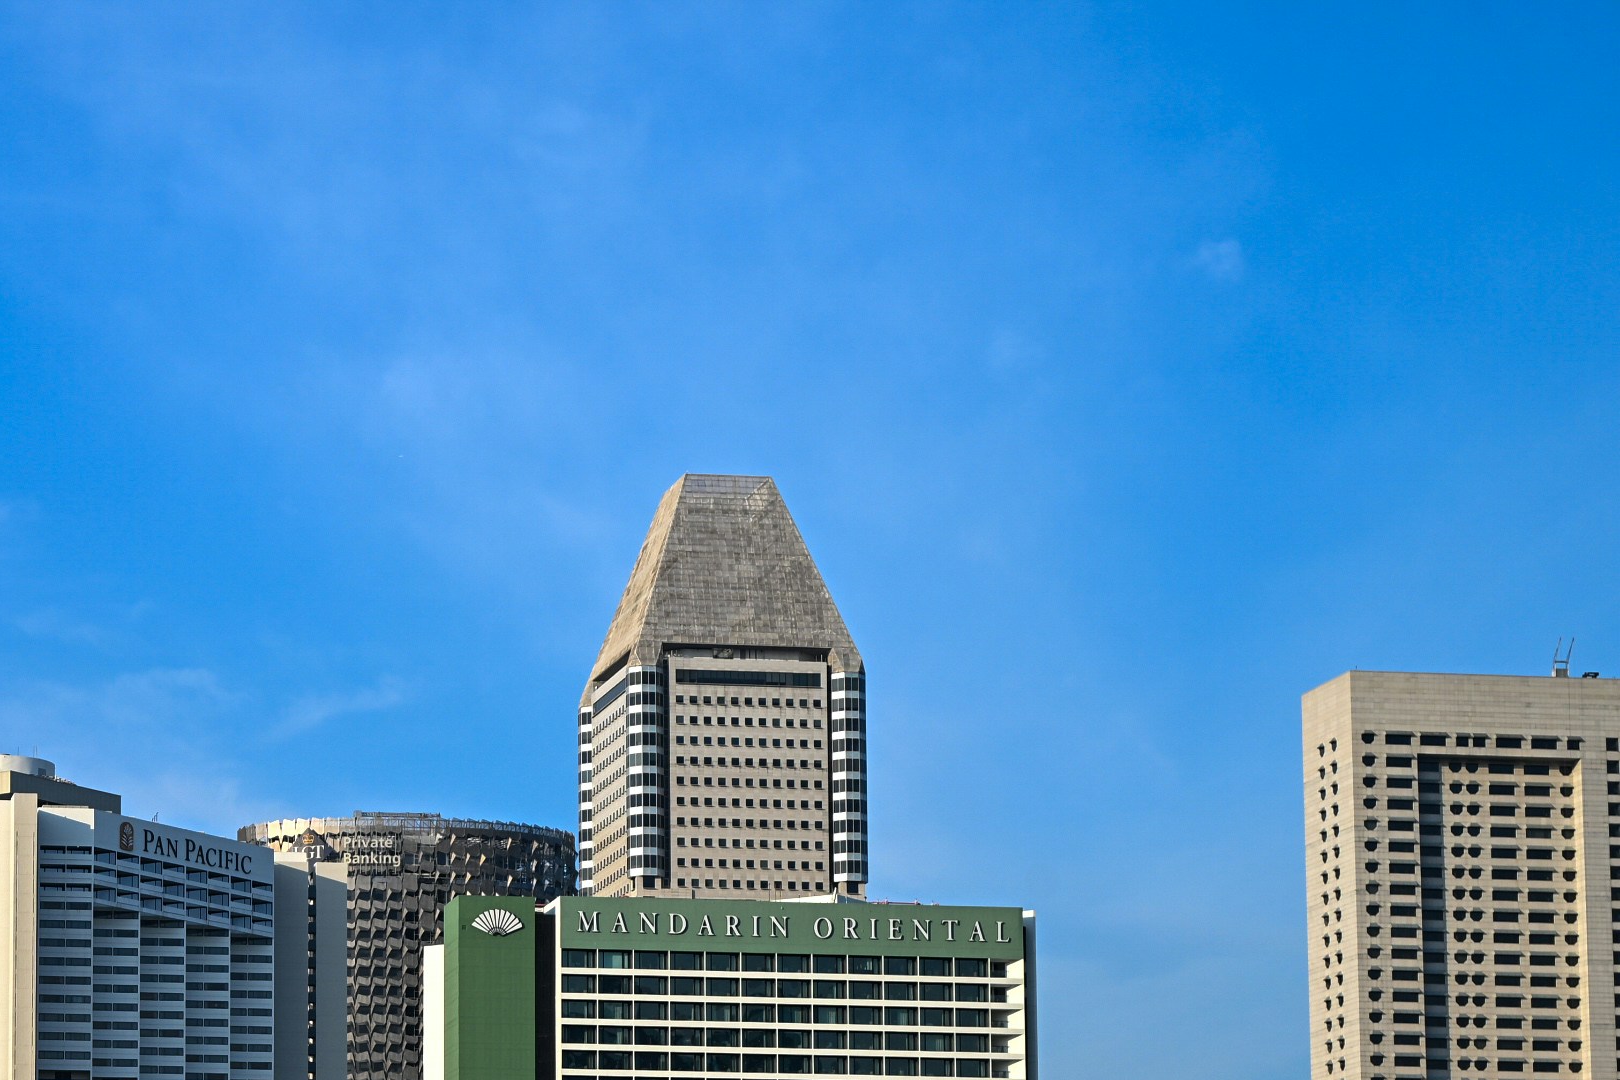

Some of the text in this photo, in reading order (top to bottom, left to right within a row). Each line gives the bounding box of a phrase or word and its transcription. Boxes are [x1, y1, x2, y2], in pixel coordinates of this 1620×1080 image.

[143, 829, 252, 875] PAN PACIFIC
[343, 836, 393, 849] Private
[343, 852, 401, 867] Banking
[577, 910, 1011, 943] MANDARIN ORIENTAL
